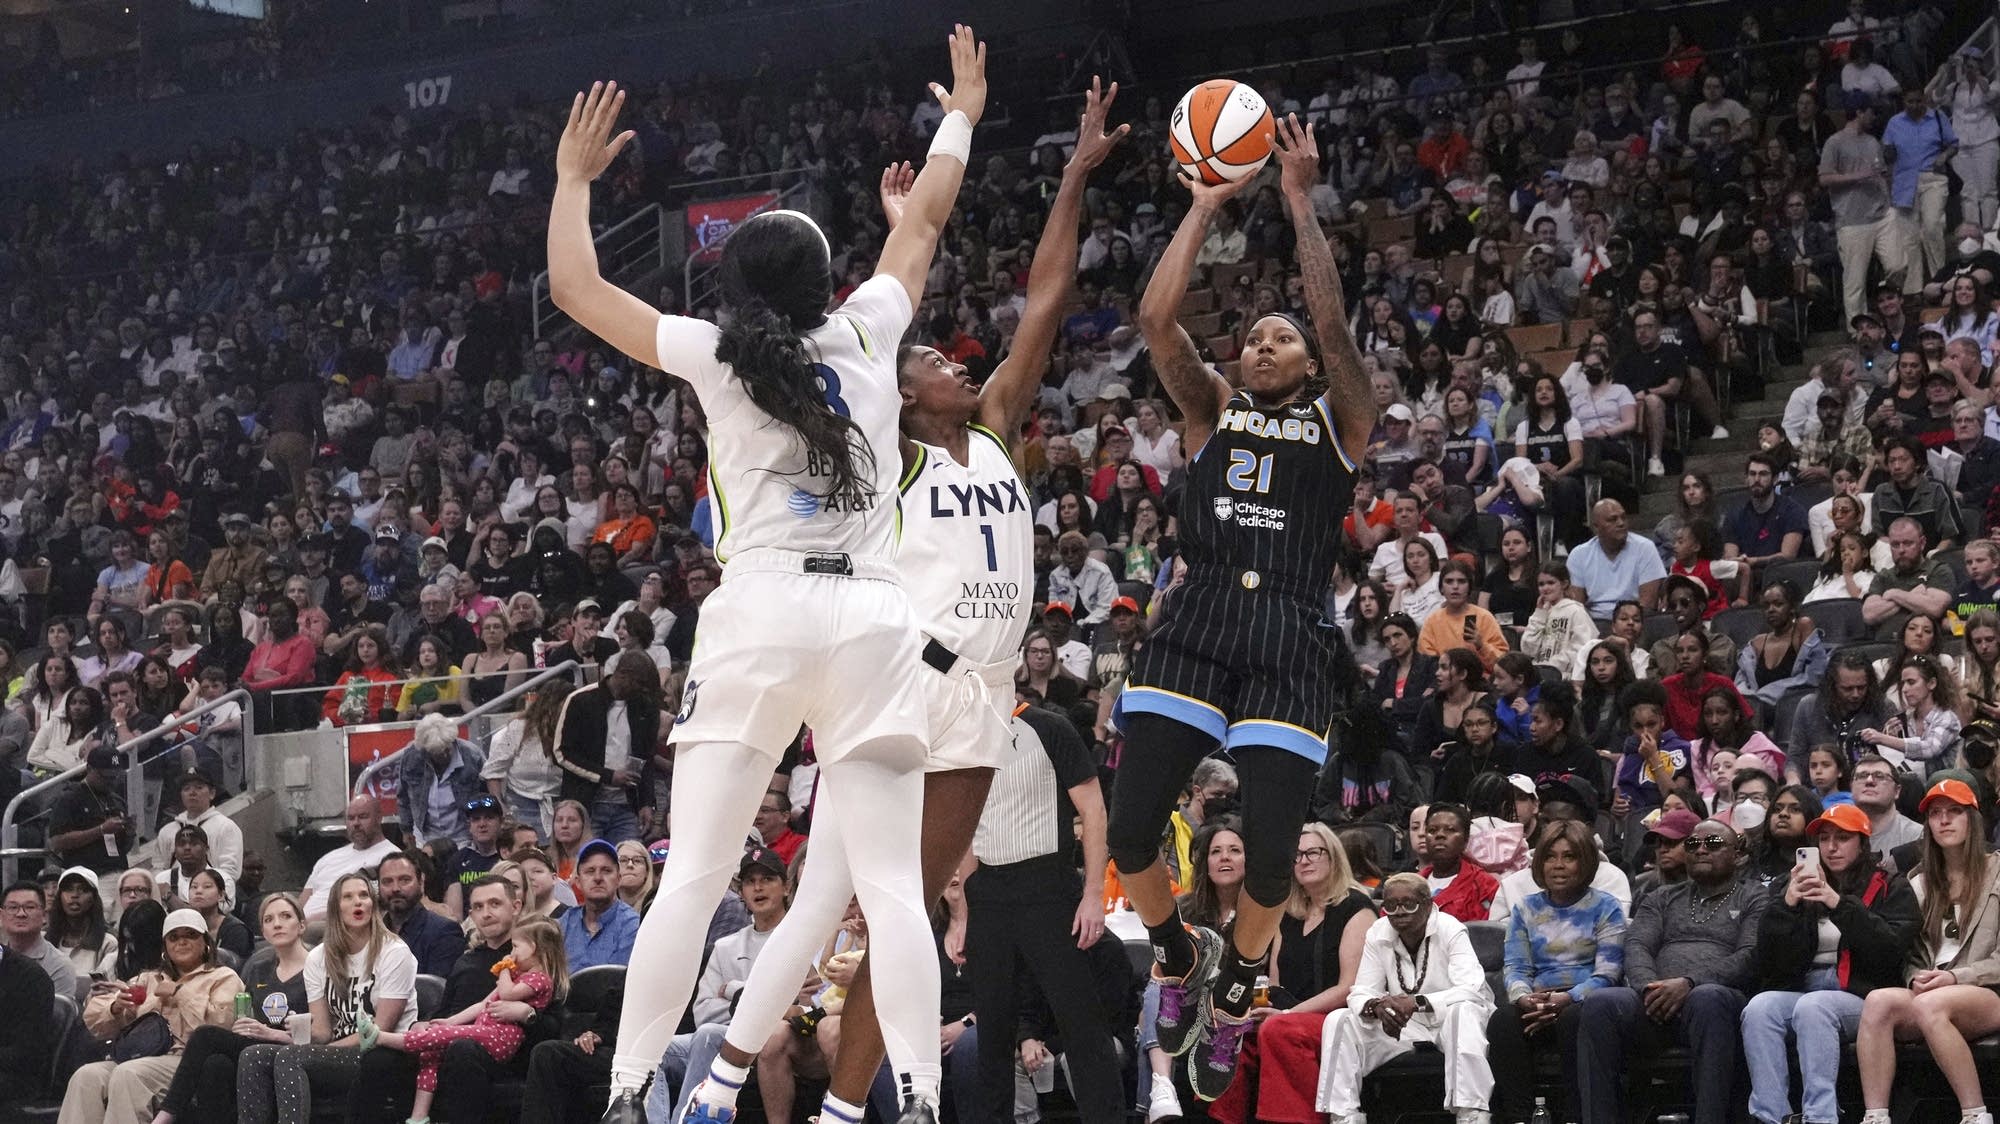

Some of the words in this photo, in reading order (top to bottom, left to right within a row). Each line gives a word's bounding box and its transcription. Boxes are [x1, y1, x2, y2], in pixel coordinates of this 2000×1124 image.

[404, 75, 451, 109] 107
[1217, 409, 1320, 445] HICAGO
[1226, 448, 1274, 494] 21
[930, 478, 1026, 518] LYNX
[1236, 515, 1285, 531] edicine
[979, 525, 998, 571] 1
[961, 582, 1019, 599] MAYO
